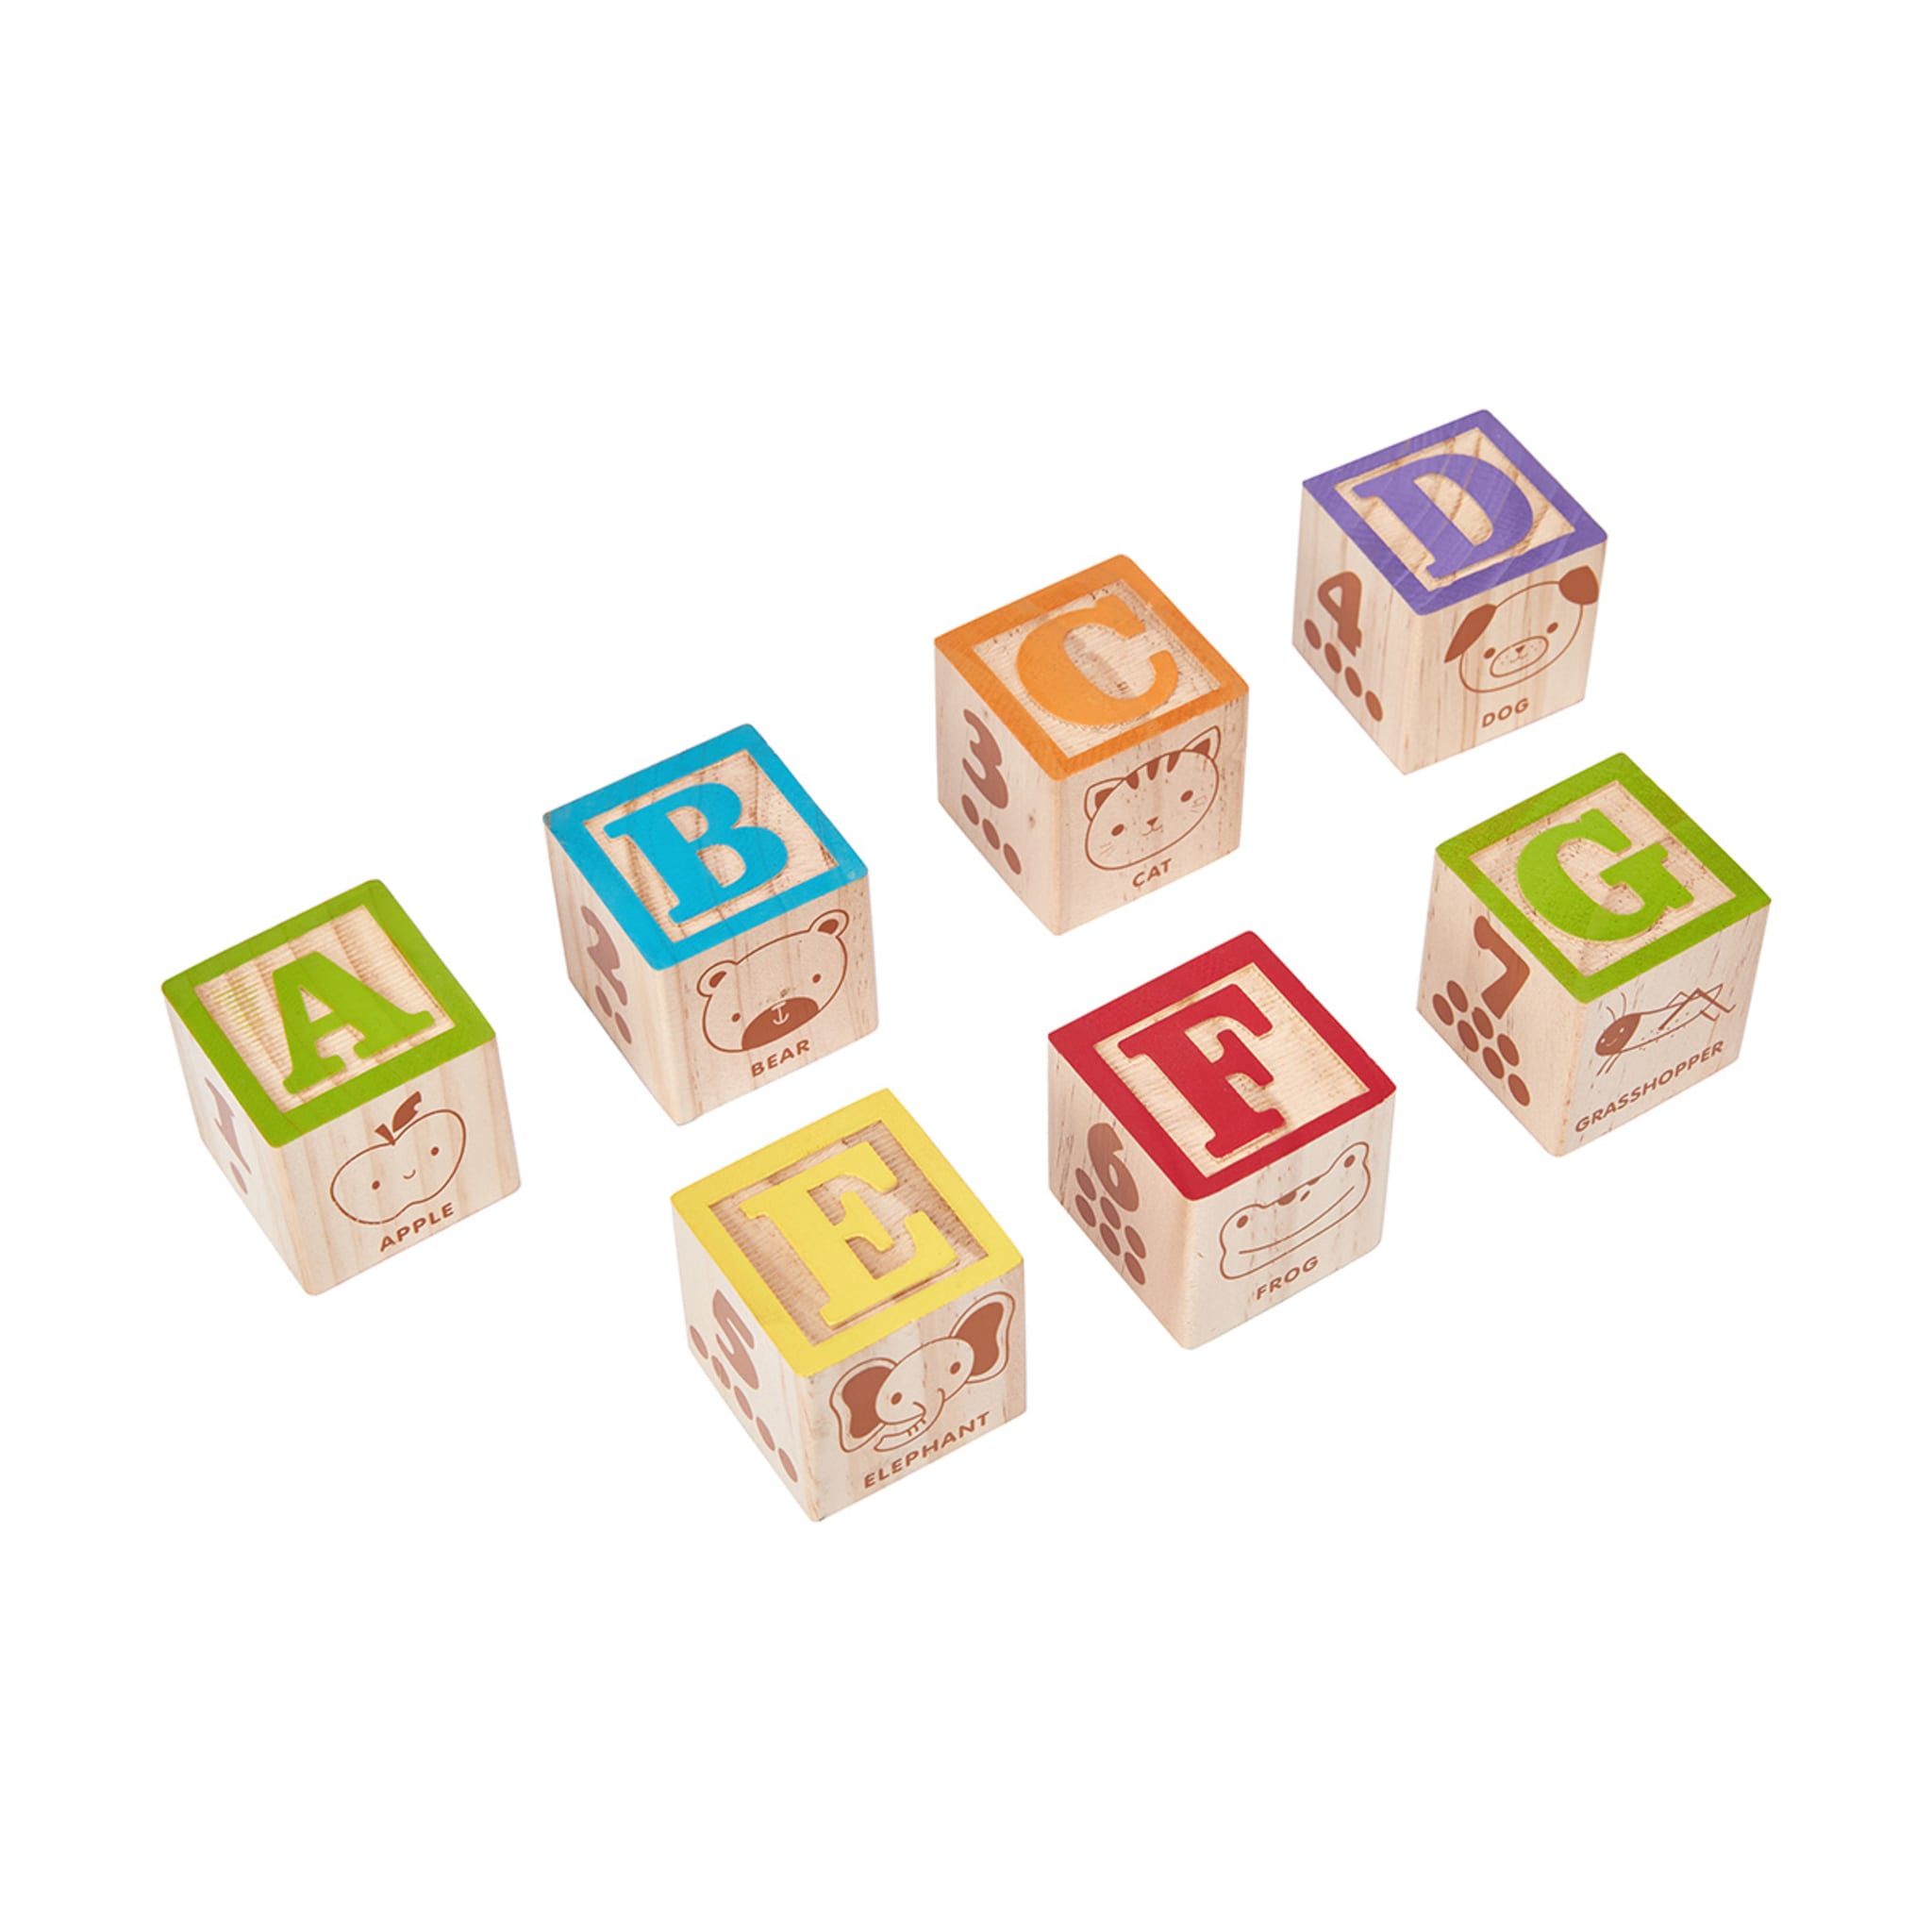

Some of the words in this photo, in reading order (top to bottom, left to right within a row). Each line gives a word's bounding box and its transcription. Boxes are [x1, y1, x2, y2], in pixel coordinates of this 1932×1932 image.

[1352, 453, 1534, 578] D
[1015, 593, 1178, 725] C
[1317, 571, 1362, 657] 4
[962, 708, 1008, 809] 3
[1482, 697, 1529, 728] DOG
[603, 782, 789, 924] B
[1132, 858, 1173, 888] CAT
[1516, 808, 1694, 941] G
[580, 905, 627, 1007] 2
[1474, 915, 1530, 1020] 7
[283, 951, 435, 1094] A
[750, 1039, 810, 1078] BEAR
[1117, 983, 1287, 1158] F
[204, 1077, 252, 1174] 1
[1574, 1040, 1724, 1133] GRASSHOPPER
[1087, 1123, 1140, 1212] 6
[379, 1202, 455, 1252] APPLE
[740, 1141, 958, 1327] E
[1256, 1256, 1319, 1300] FROG
[712, 1289, 759, 1390] 5
[863, 1411, 991, 1490] ELEPHANT
